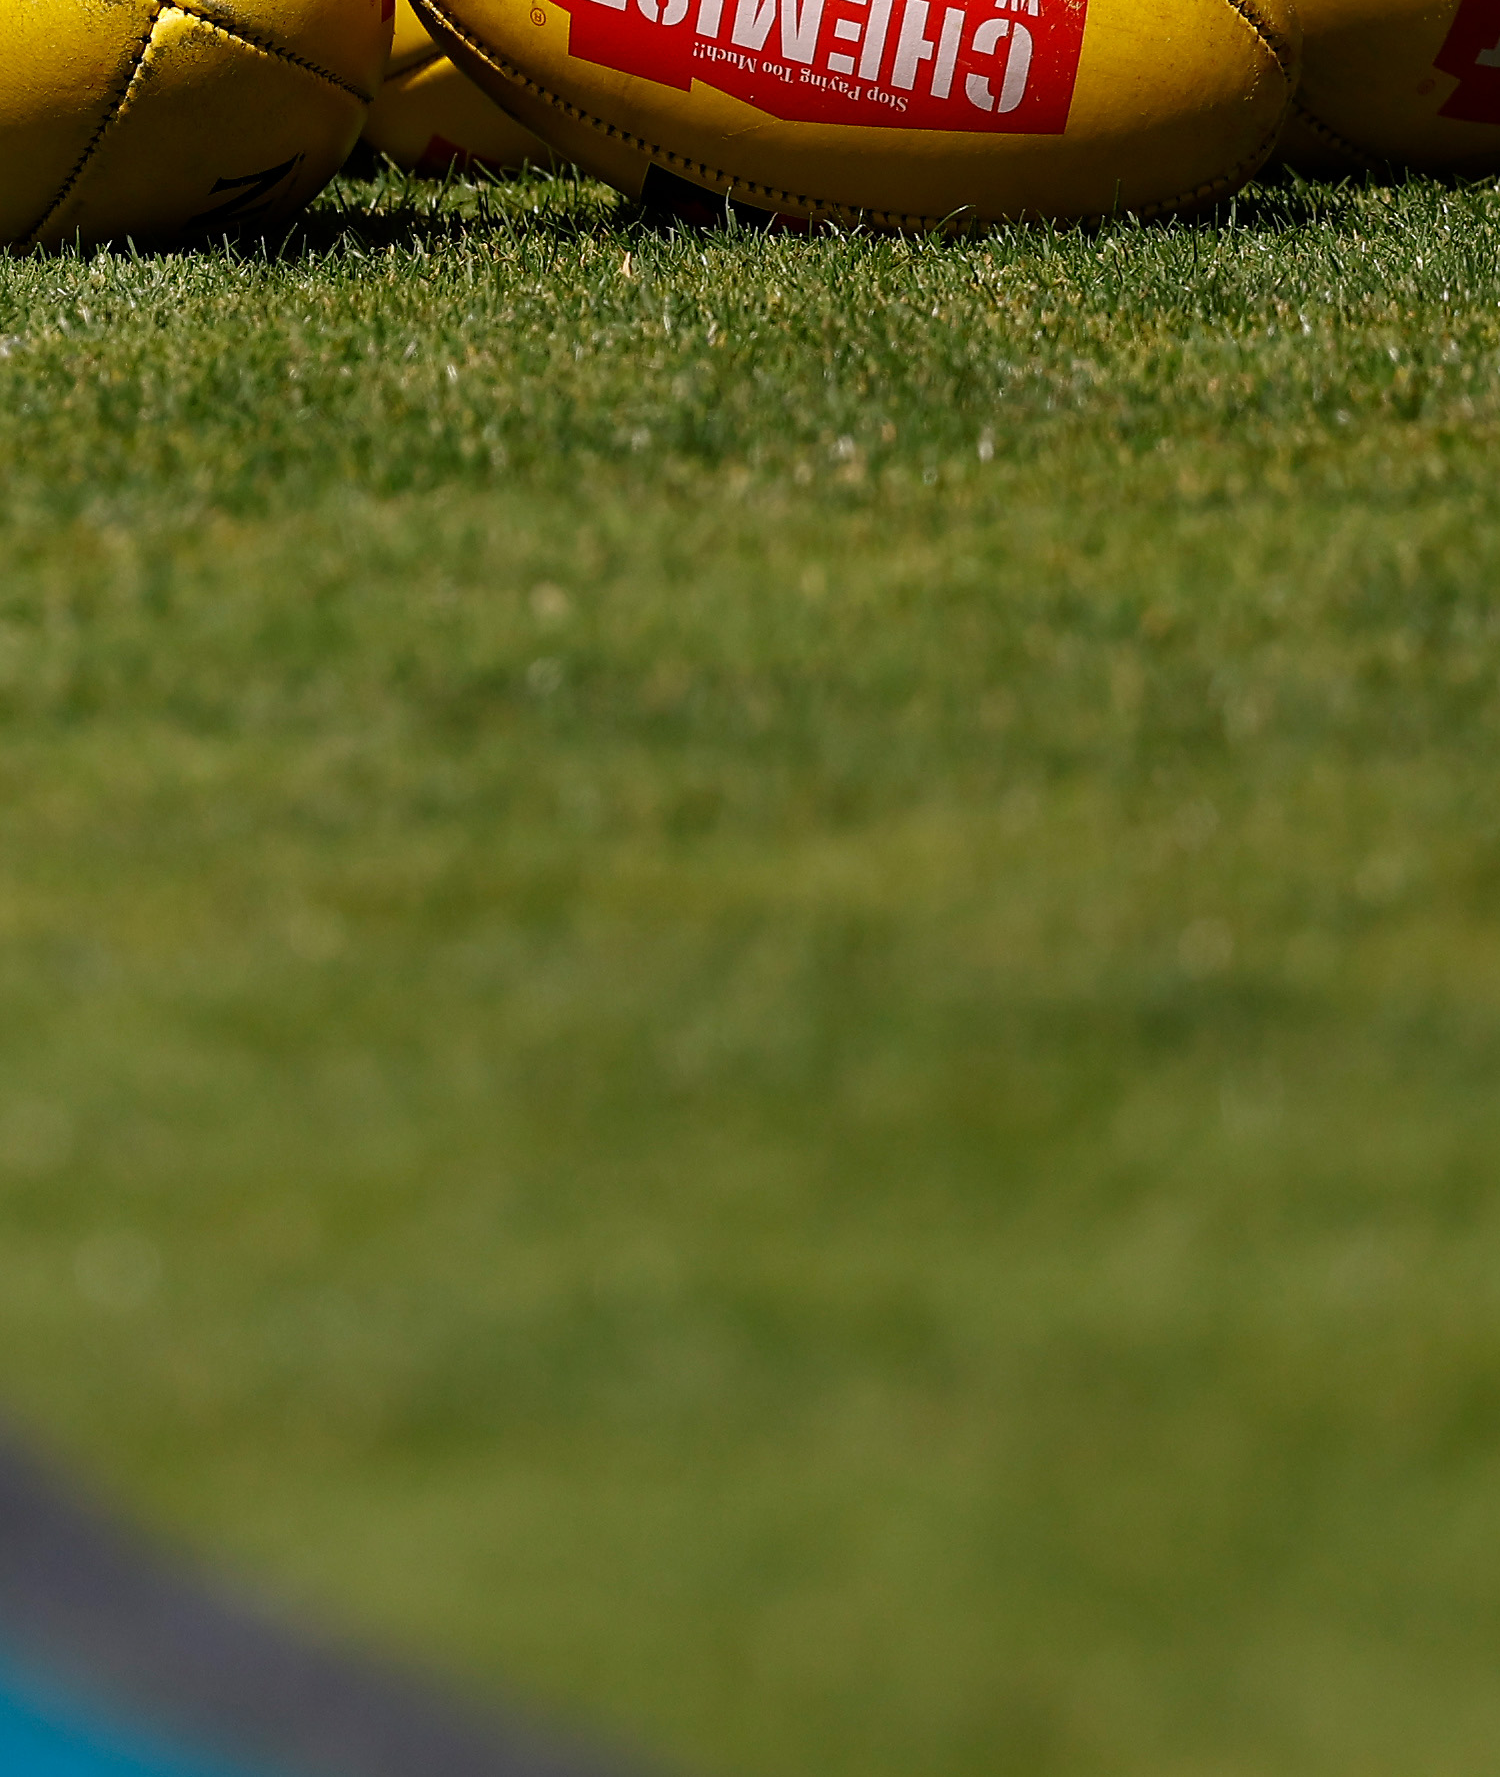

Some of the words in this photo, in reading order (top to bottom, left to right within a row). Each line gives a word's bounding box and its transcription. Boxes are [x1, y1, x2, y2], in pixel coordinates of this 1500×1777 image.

[692, 41, 757, 73] Much!!
[762, 61, 794, 84] Too
[800, 68, 861, 100] Paying
[866, 86, 909, 113] Stop
